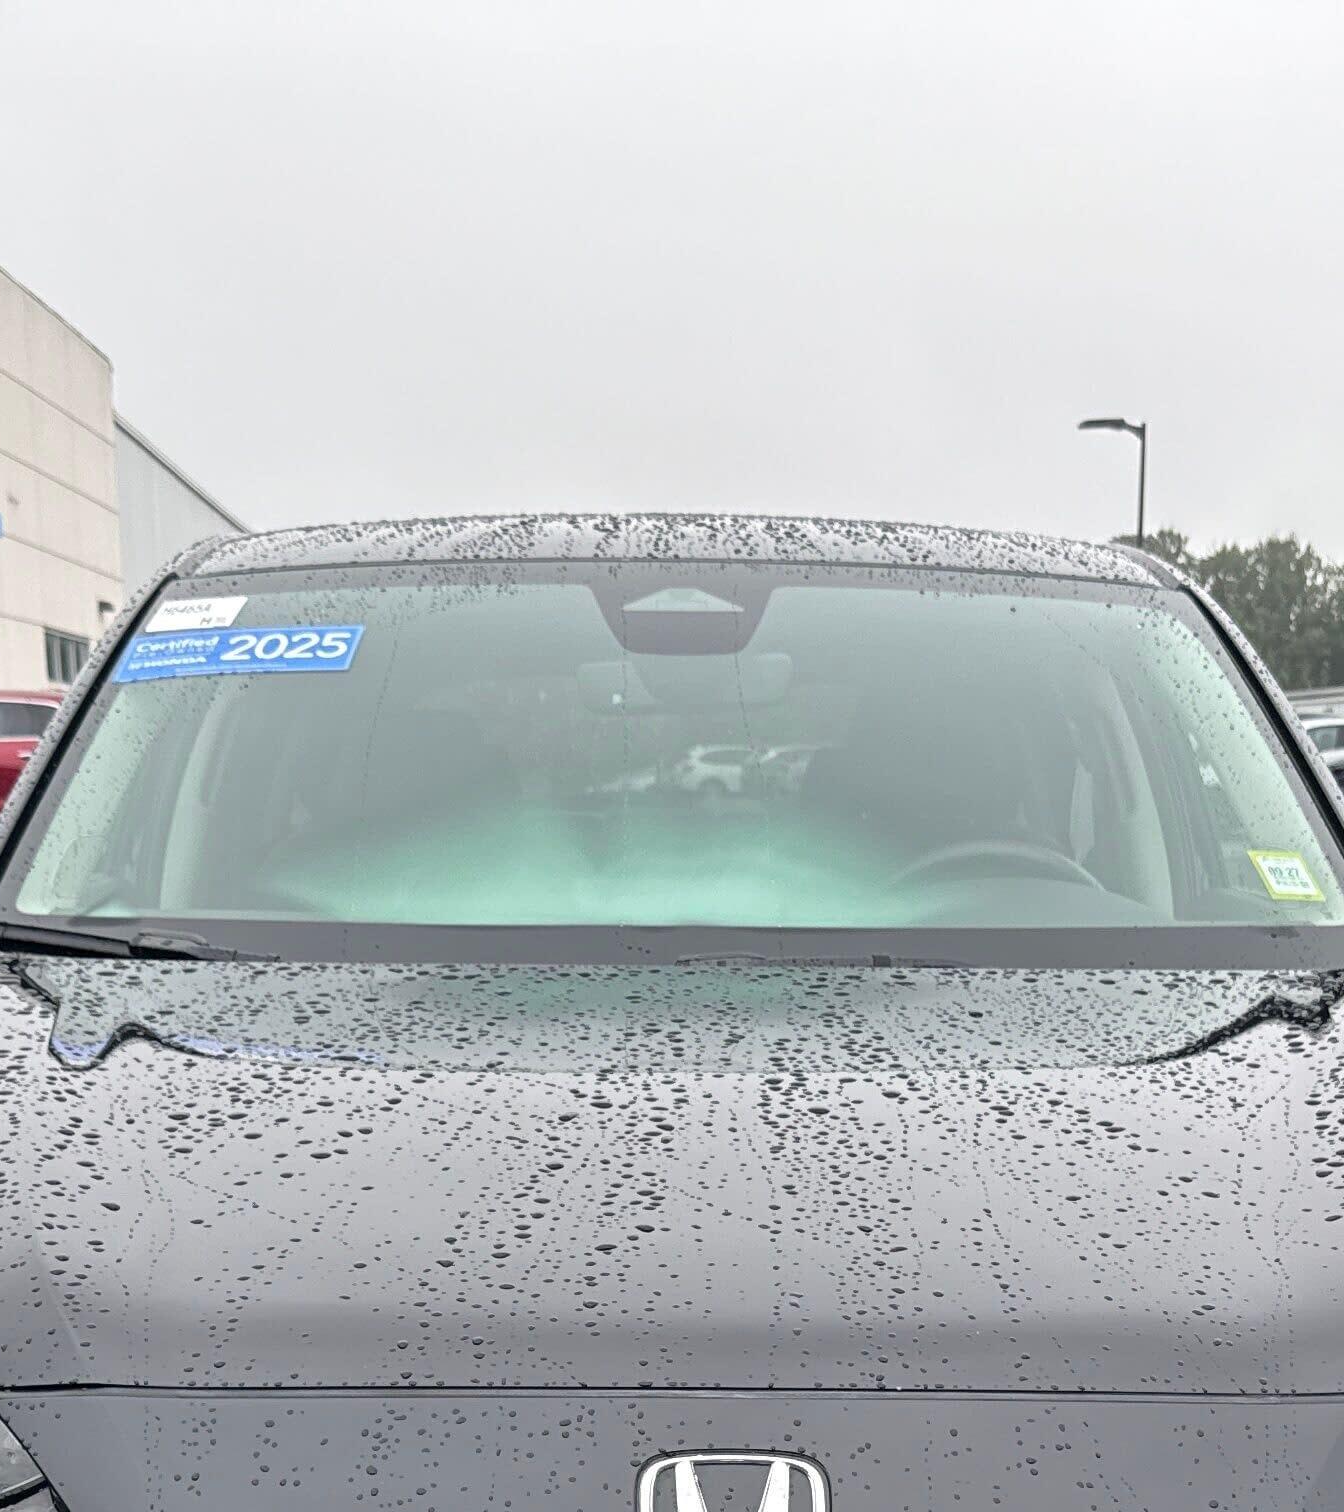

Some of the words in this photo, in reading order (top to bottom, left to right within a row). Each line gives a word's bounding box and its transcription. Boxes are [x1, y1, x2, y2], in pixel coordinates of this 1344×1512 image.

[136, 636, 220, 653] Certified
[219, 632, 352, 661] 2025
[144, 656, 207, 667] HONDA
